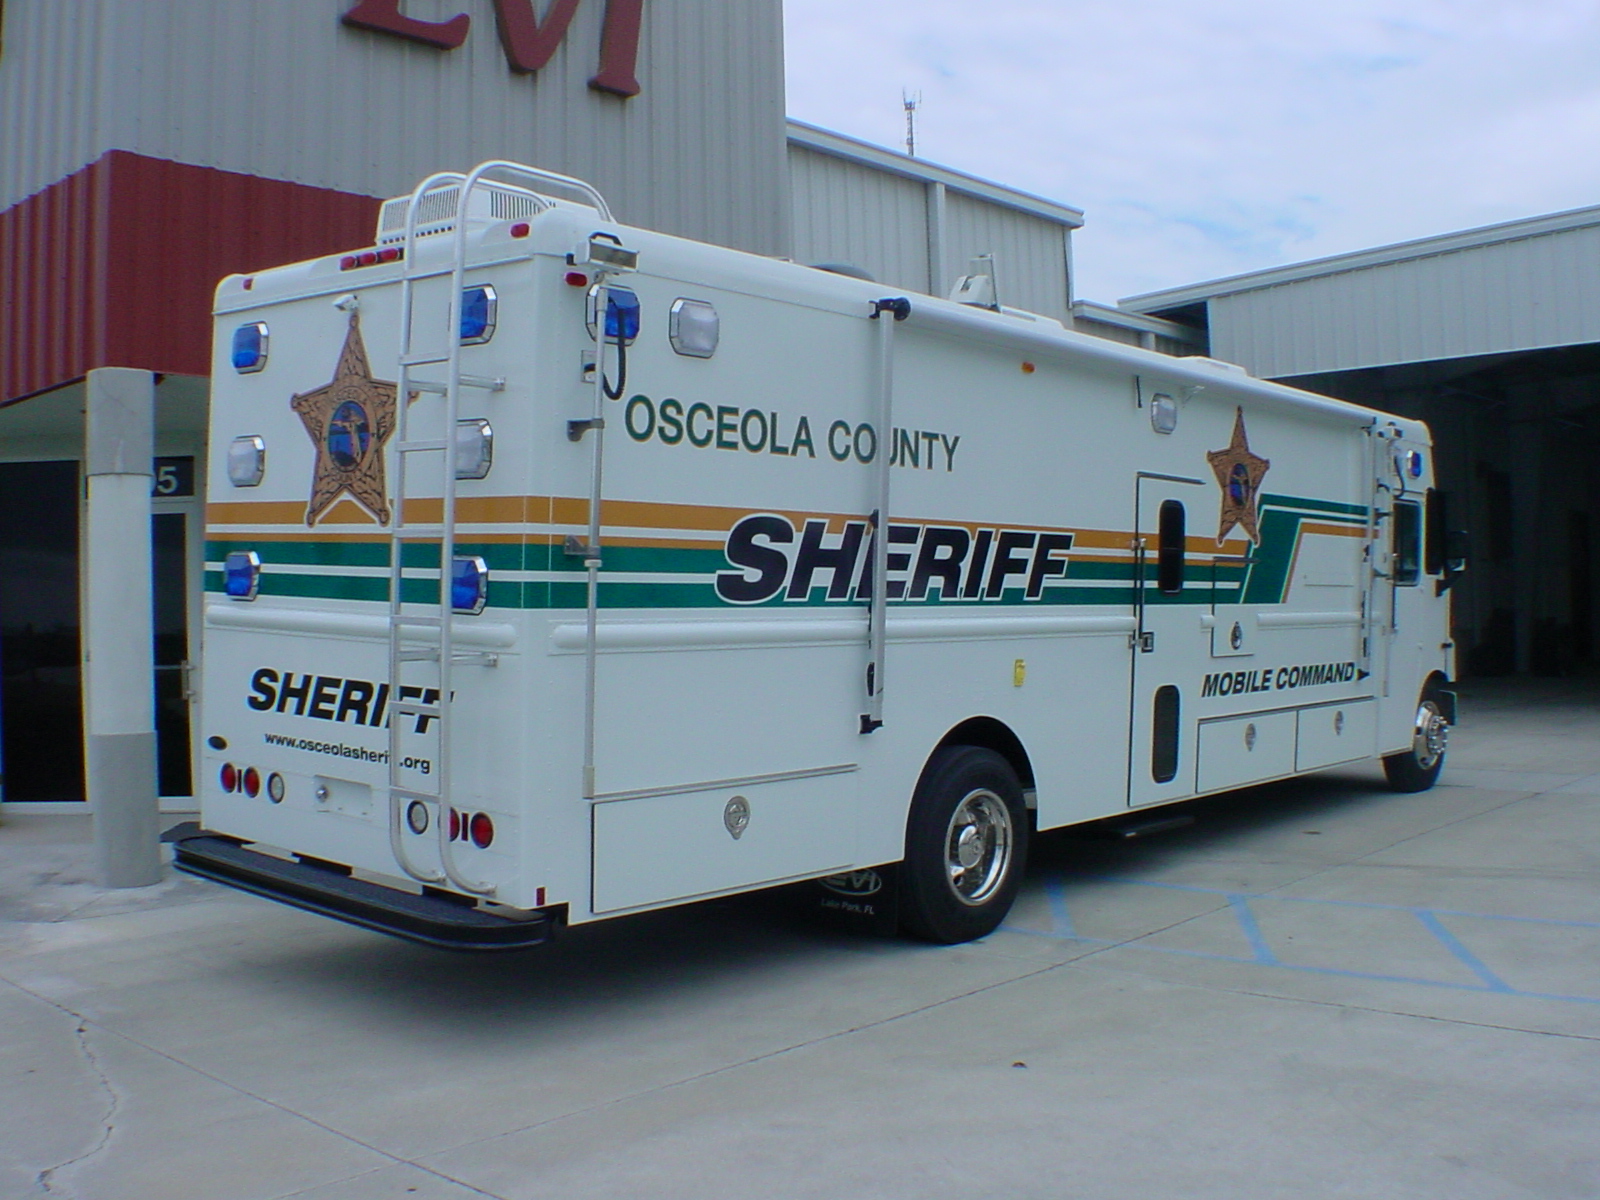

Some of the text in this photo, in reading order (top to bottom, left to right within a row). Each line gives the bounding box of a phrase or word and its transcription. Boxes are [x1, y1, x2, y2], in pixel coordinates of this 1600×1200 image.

[624, 394, 816, 458] OSCEOLA
[714, 512, 1075, 604] SHERIFF
[1201, 661, 1356, 698] MOBILE COMMAND
[264, 732, 431, 775] www.osceolasheri.org
[863, 904, 875, 915] FL
